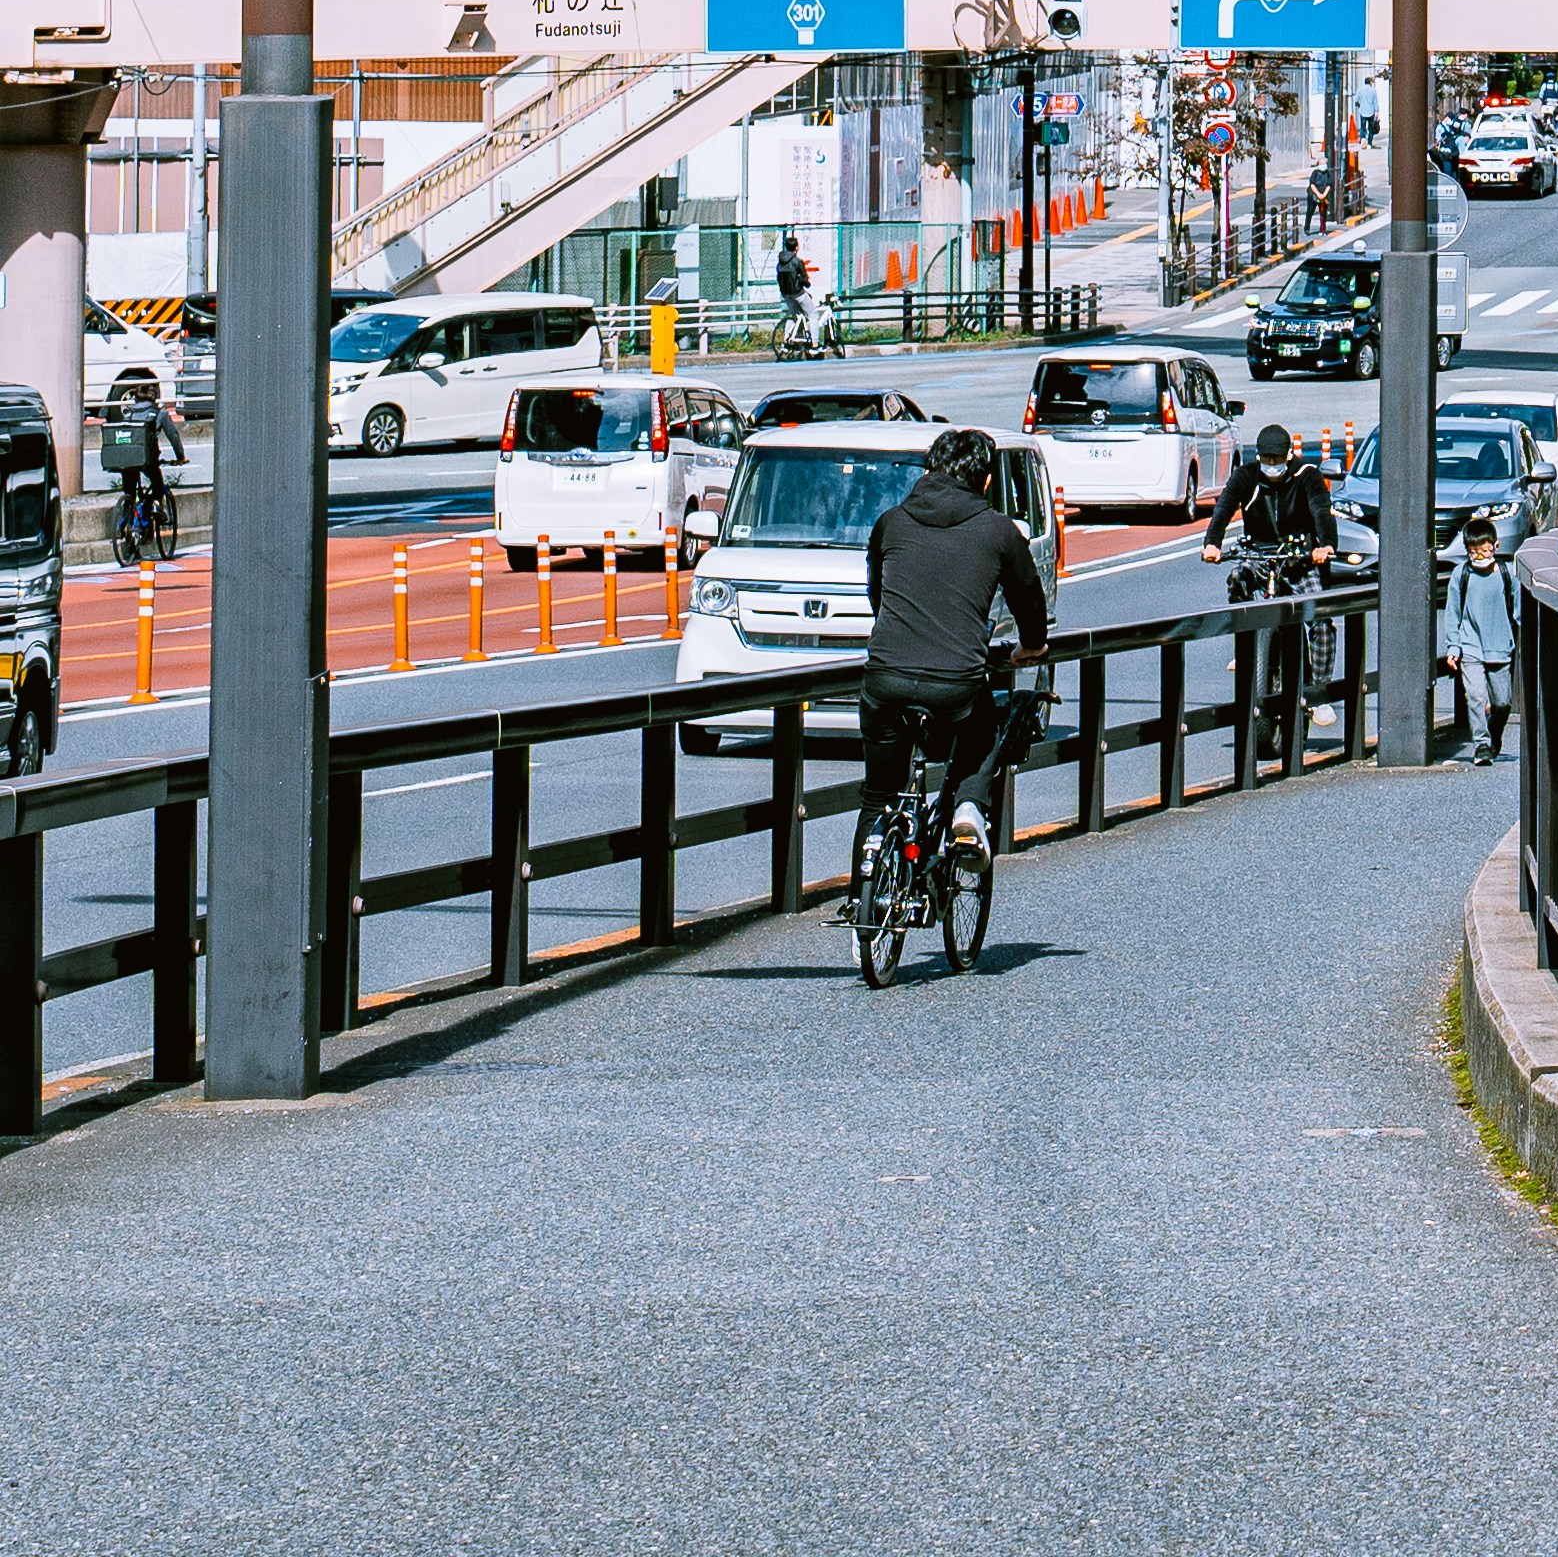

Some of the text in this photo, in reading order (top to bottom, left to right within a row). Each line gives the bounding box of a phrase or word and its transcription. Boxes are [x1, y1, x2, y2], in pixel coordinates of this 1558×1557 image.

[792, 4, 820, 22] 301
[535, 20, 621, 38] Fudanotsuji
[1471, 172, 1519, 183] POLICE
